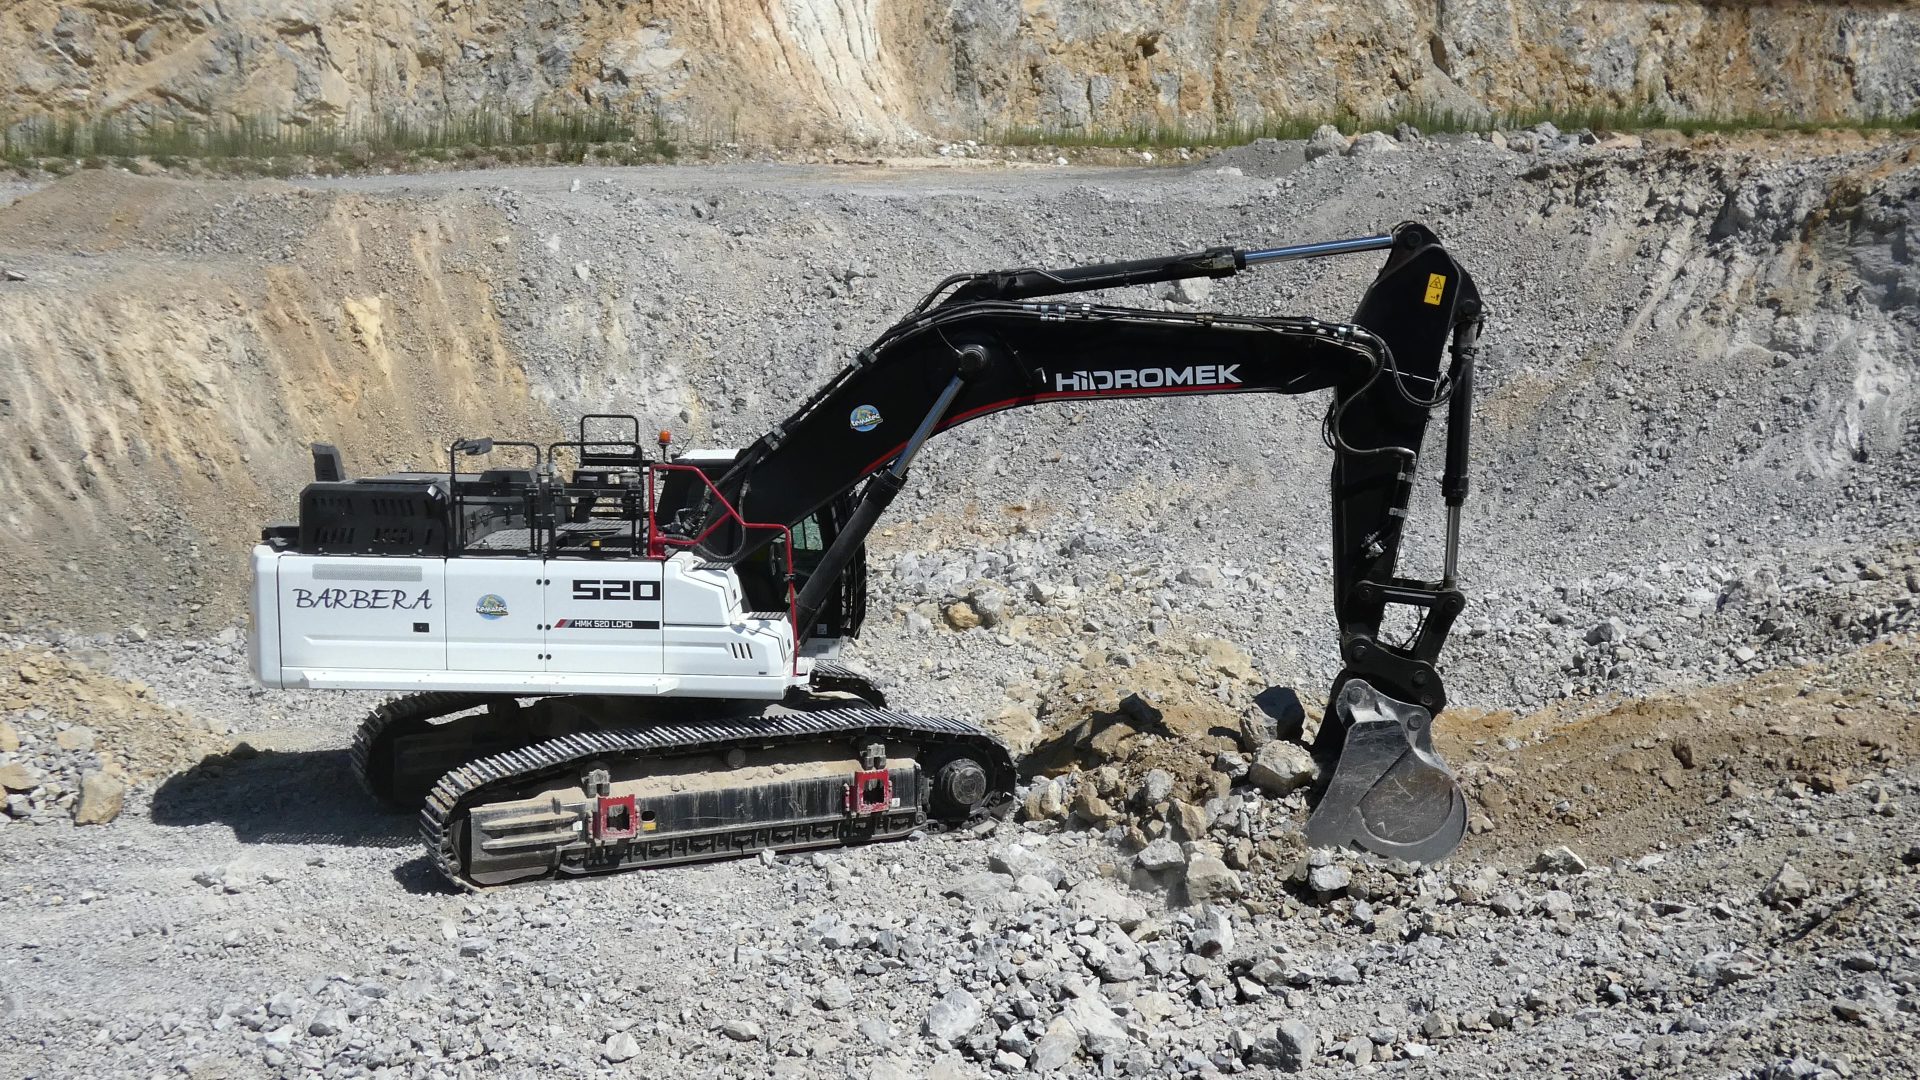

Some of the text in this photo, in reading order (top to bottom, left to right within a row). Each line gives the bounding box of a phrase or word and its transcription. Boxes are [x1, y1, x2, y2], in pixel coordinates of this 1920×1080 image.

[292, 588, 432, 609] BARBERA
[573, 580, 660, 601] 520
[574, 620, 593, 628] HMK
[594, 620, 610, 628] 520
